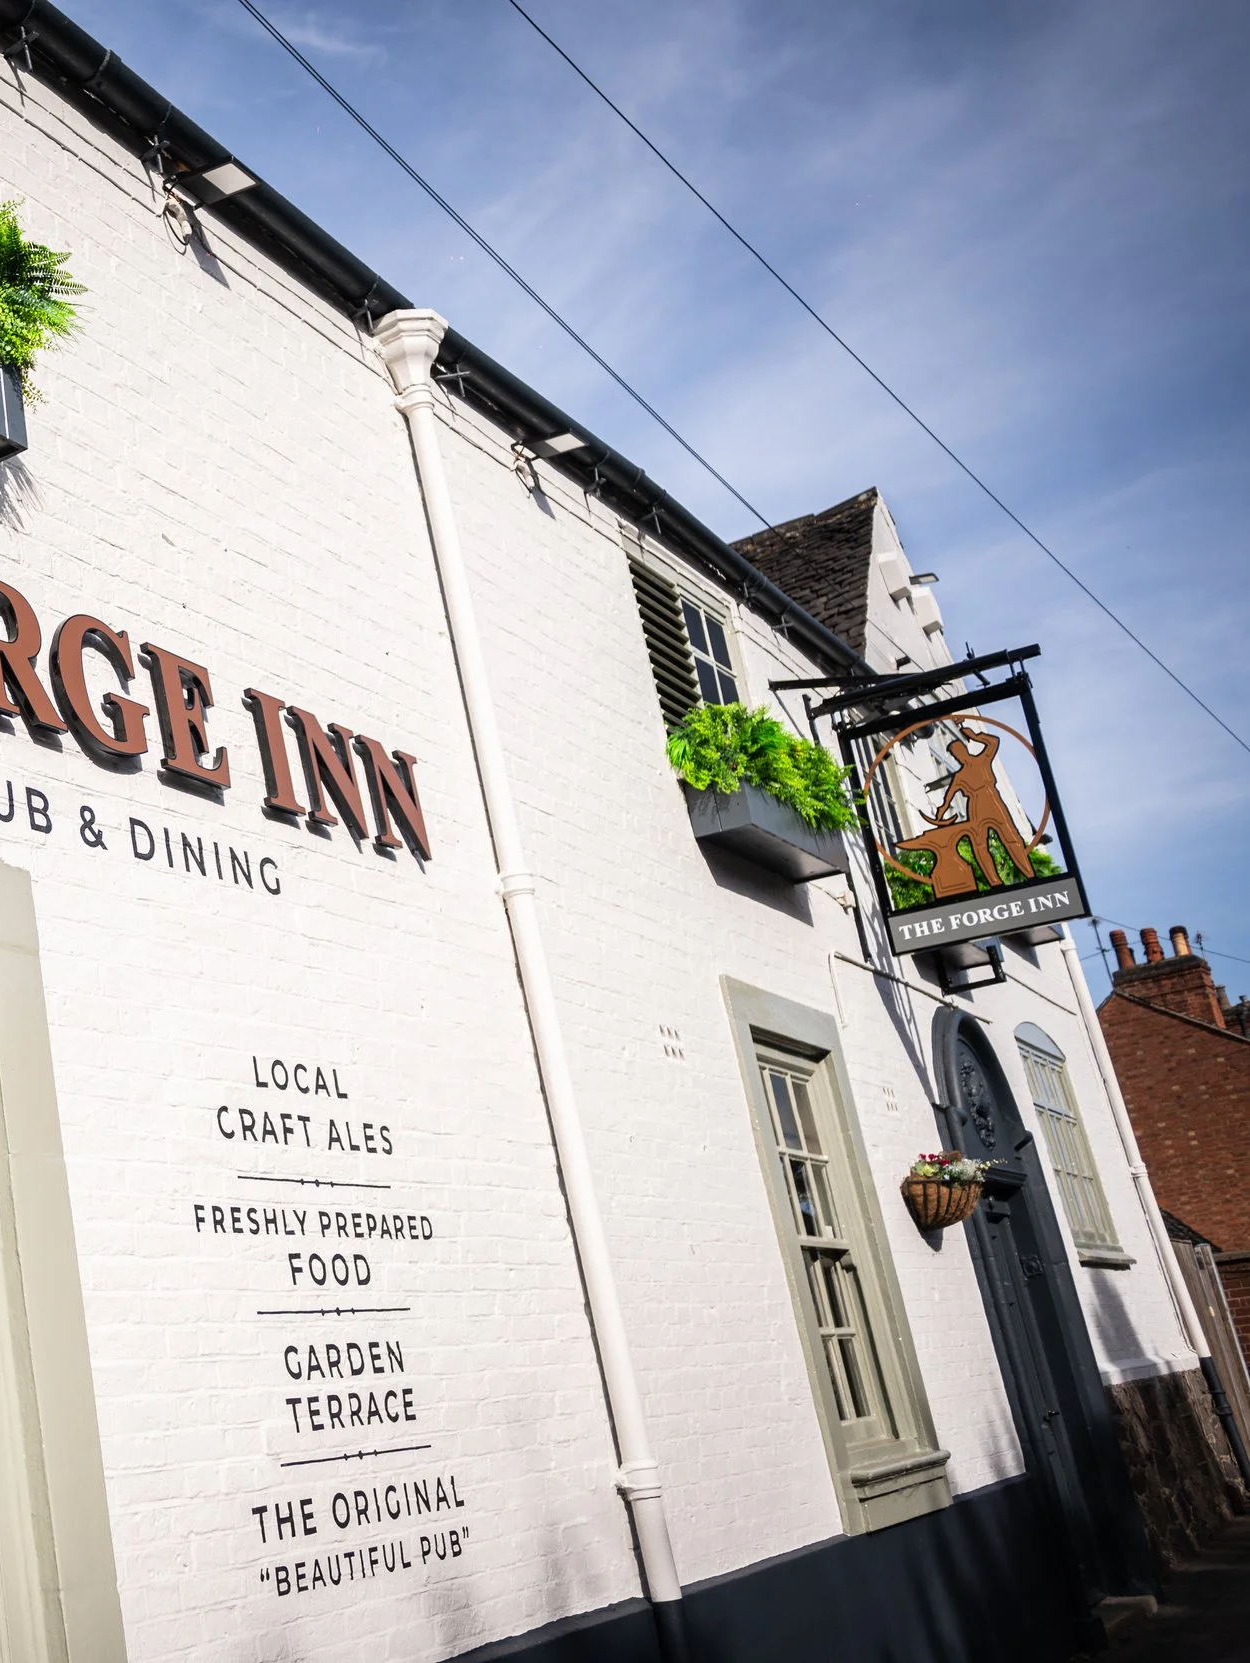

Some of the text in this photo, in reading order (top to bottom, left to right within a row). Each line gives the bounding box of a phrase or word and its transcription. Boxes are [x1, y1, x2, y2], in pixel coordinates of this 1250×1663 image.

[244, 687, 432, 862] INN
[79, 805, 107, 850] &
[129, 816, 283, 896] DINING
[899, 892, 1070, 940] THE FORGE INN
[252, 1055, 349, 1099] LOCAL
[216, 1105, 394, 1155] CRAFT ALES
[193, 1203, 434, 1241] FRESHLY PREPARED
[287, 1252, 372, 1286] FOOD
[283, 1340, 405, 1381] GARDEN
[285, 1387, 417, 1434] TERRACE
[251, 1475, 465, 1544] THE ORIGINAL
